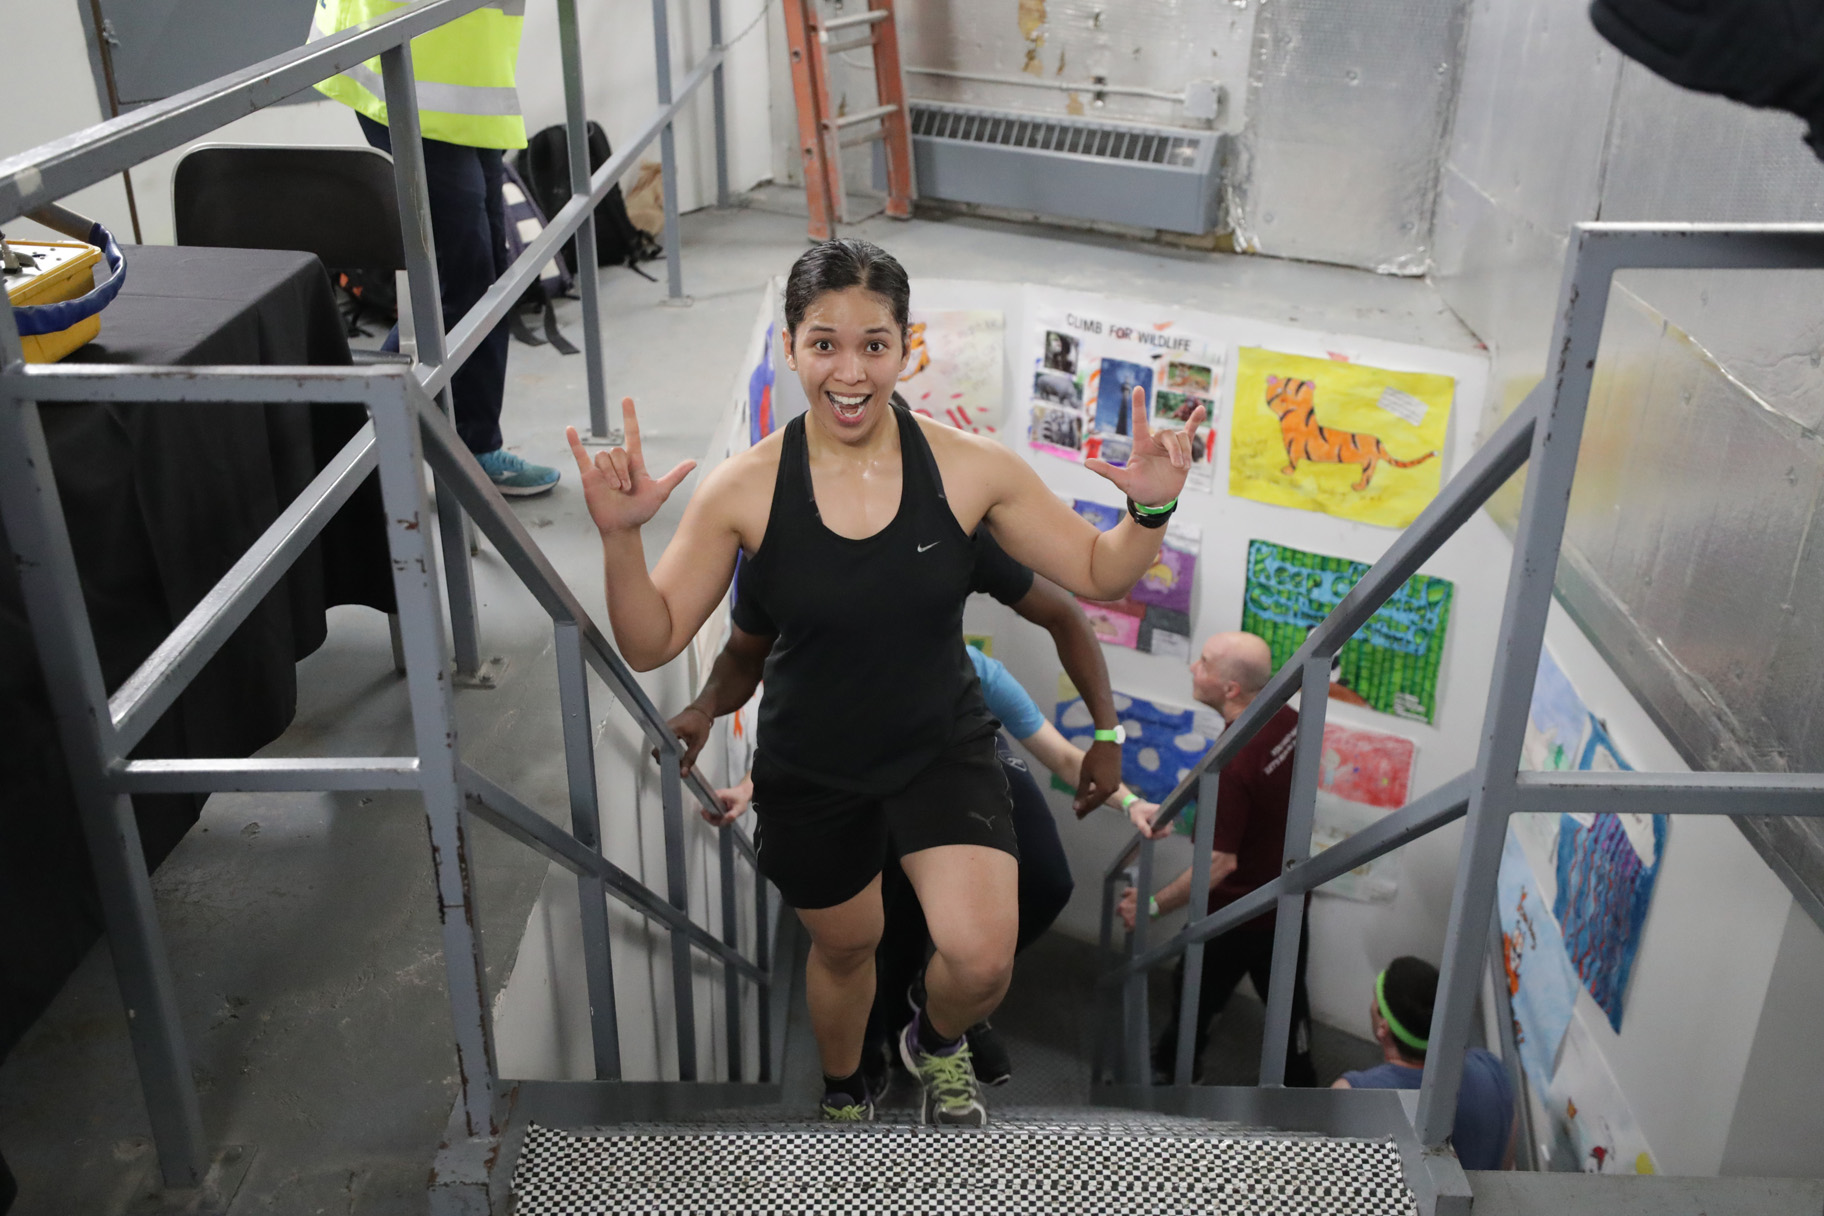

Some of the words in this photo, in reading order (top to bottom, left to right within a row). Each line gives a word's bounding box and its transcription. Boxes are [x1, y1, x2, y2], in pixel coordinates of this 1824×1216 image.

[1066, 312, 1103, 335] CLIMB
[1109, 324, 1133, 341] FOR
[1137, 330, 1192, 351] WILDLIFE
[1252, 545, 1323, 597] Keep
